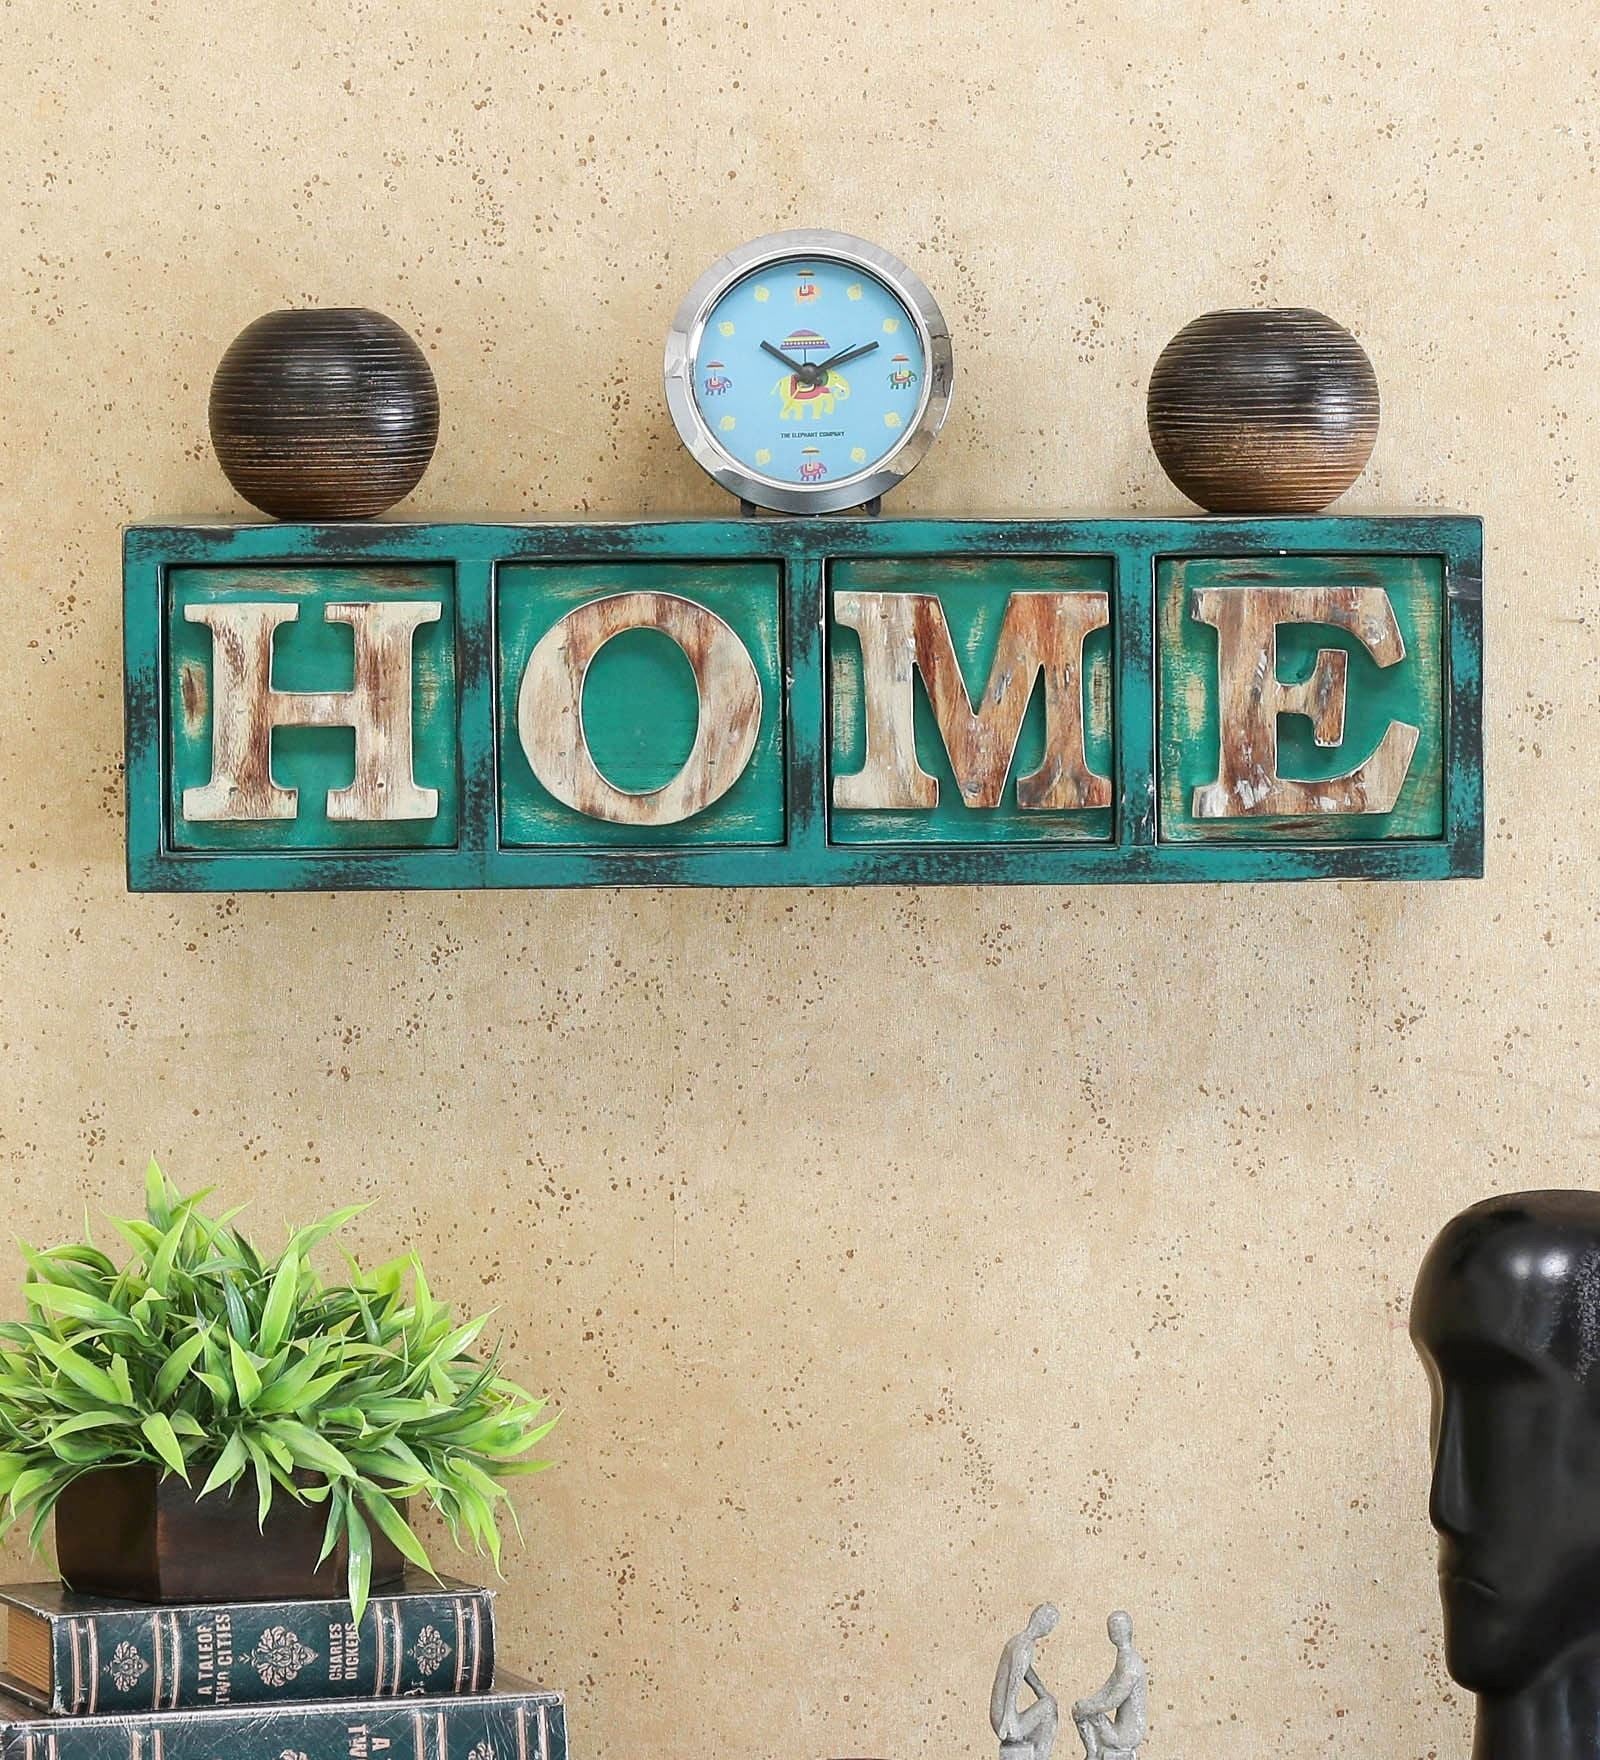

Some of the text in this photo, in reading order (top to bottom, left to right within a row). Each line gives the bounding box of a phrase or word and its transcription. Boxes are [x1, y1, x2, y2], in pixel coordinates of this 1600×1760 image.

[182, 585, 1421, 828] HOME
[215, 1614, 233, 1666] CITIES
[328, 1623, 343, 1681] CHARLES
[344, 1622, 359, 1680] DICKENS
[197, 1685, 213, 1696] A
[347, 1723, 369, 1760] TW
